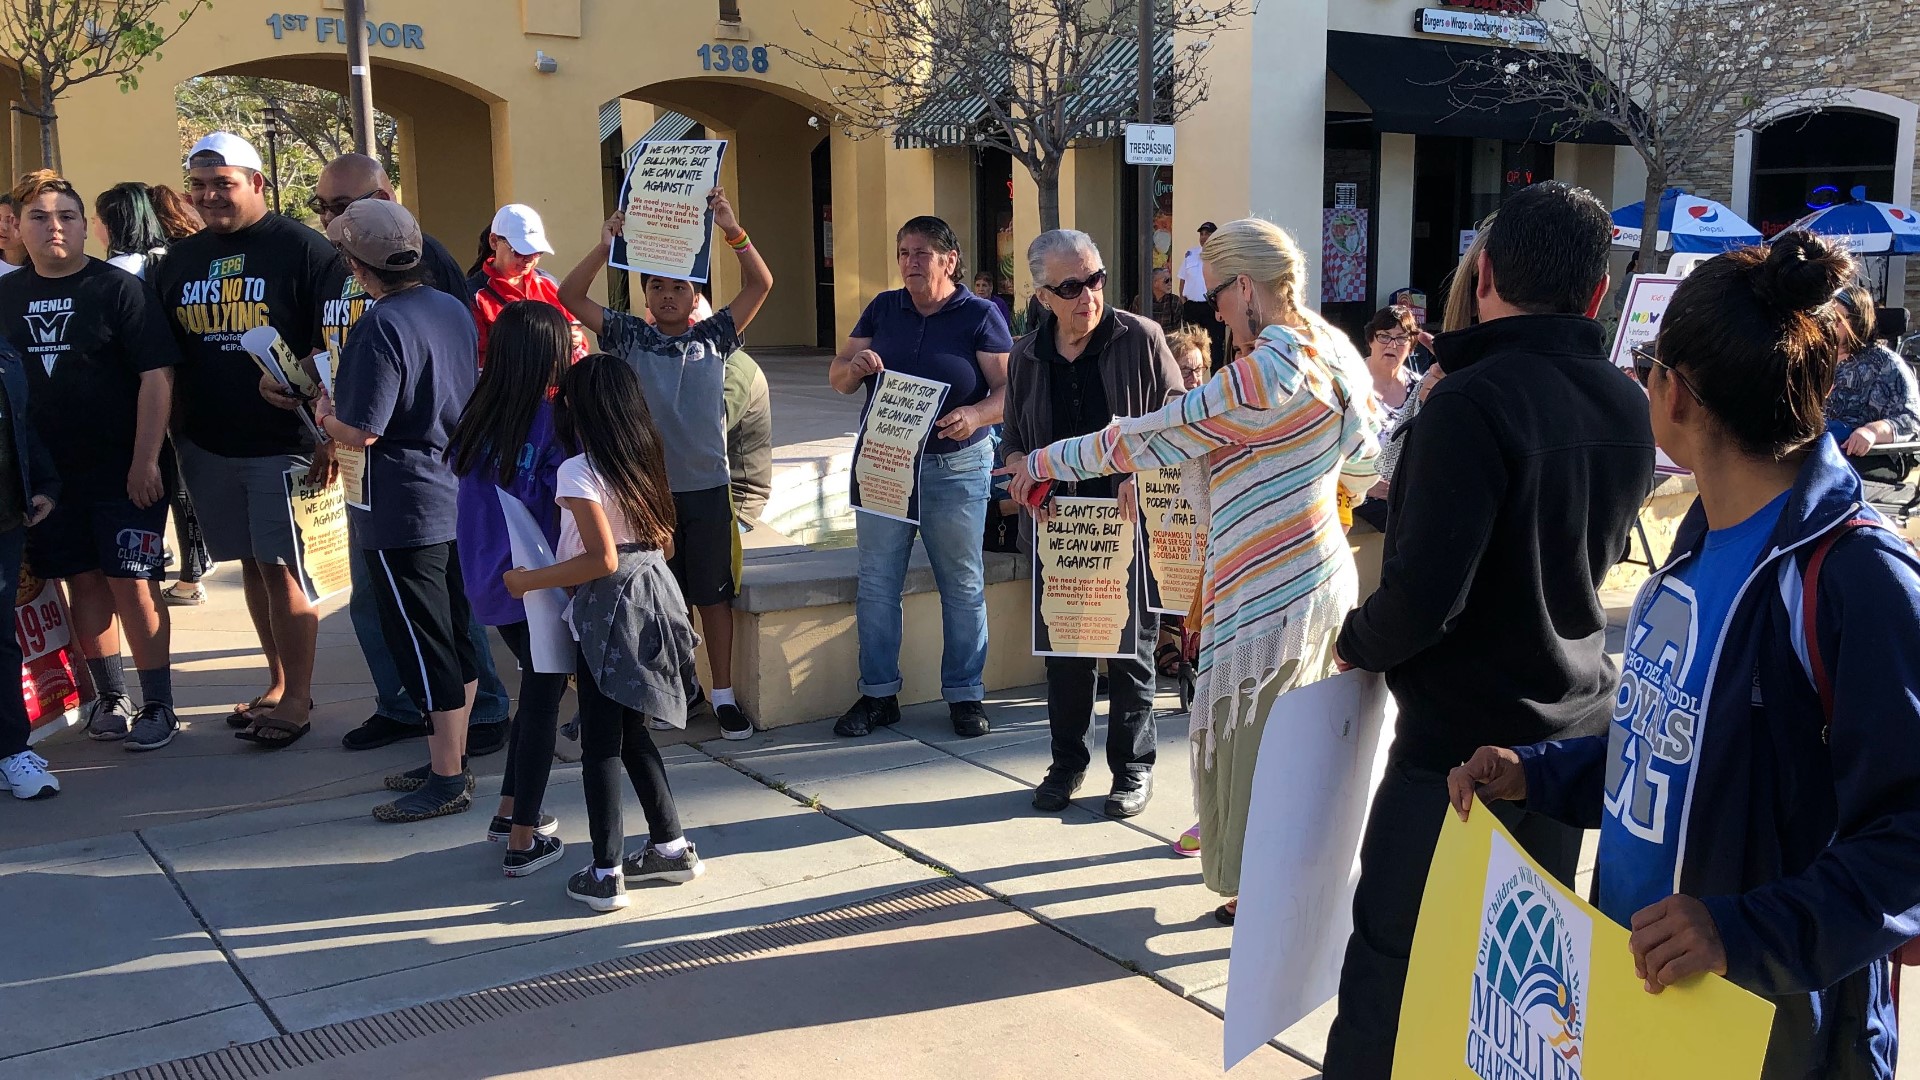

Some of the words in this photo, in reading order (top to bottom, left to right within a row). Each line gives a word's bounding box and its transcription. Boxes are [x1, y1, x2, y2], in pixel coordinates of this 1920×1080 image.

[266, 13, 309, 39] 1ST
[1424, 14, 1444, 30] Burgers
[1451, 17, 1468, 33] Wraps
[697, 43, 769, 73] 1388
[649, 145, 661, 154] WE
[690, 146, 712, 154] STOP
[1129, 142, 1172, 155] TRESPASSING
[690, 158, 710, 168] BUT
[641, 168, 655, 177] WE
[656, 168, 676, 179] CAN
[676, 170, 703, 180] UNITE
[644, 180, 684, 194] AGAINST
[685, 184, 694, 196] IT
[677, 202, 690, 212] help
[629, 211, 663, 220] community
[1699, 225, 1725, 233] pepsi
[221, 258, 241, 275] EPG
[181, 280, 220, 305] SAYS
[221, 278, 243, 302] NO
[244, 277, 265, 301] TO
[28, 298, 72, 313] MENLO
[322, 299, 350, 326] SAYS
[1631, 312, 1660, 324] NOW
[886, 378, 898, 390] WE
[920, 386, 936, 398] STOP
[916, 400, 932, 414] BUT
[876, 406, 889, 418] WE
[888, 410, 904, 422] CAN
[902, 412, 923, 426] UNITE
[876, 422, 906, 438] AGAINST
[904, 428, 914, 440] IT
[1146, 482, 1180, 494] BULLYING
[305, 502, 318, 515] WE
[320, 498, 334, 510] CAN
[1146, 497, 1178, 510] PODEMS
[313, 508, 345, 528] AGAINST
[1064, 504, 1095, 519] CAN'T
[1161, 512, 1188, 526] CNTRA
[1190, 514, 1197, 525] EL
[1047, 521, 1100, 536] BULLYING,
[1103, 524, 1124, 536] BUT
[1154, 530, 1184, 539] OCUPAMOS
[1049, 538, 1064, 550] WE
[1066, 538, 1088, 552] CAN
[1090, 540, 1120, 552] UNITE
[1152, 537, 1166, 545] PARA
[118, 547, 143, 562] CLIFF
[1056, 554, 1102, 570] AGAINST
[1102, 556, 1113, 570] IT
[1154, 552, 1180, 560] SOCIEDAD
[1073, 584, 1093, 594] police
[1096, 578, 1112, 587] help
[1642, 662, 1663, 686] DEL
[1487, 878, 1518, 925] Children
[1518, 866, 1534, 885] Will
[1534, 874, 1565, 928] Change
[1564, 931, 1575, 964] the
[1572, 969, 1582, 1042] World
